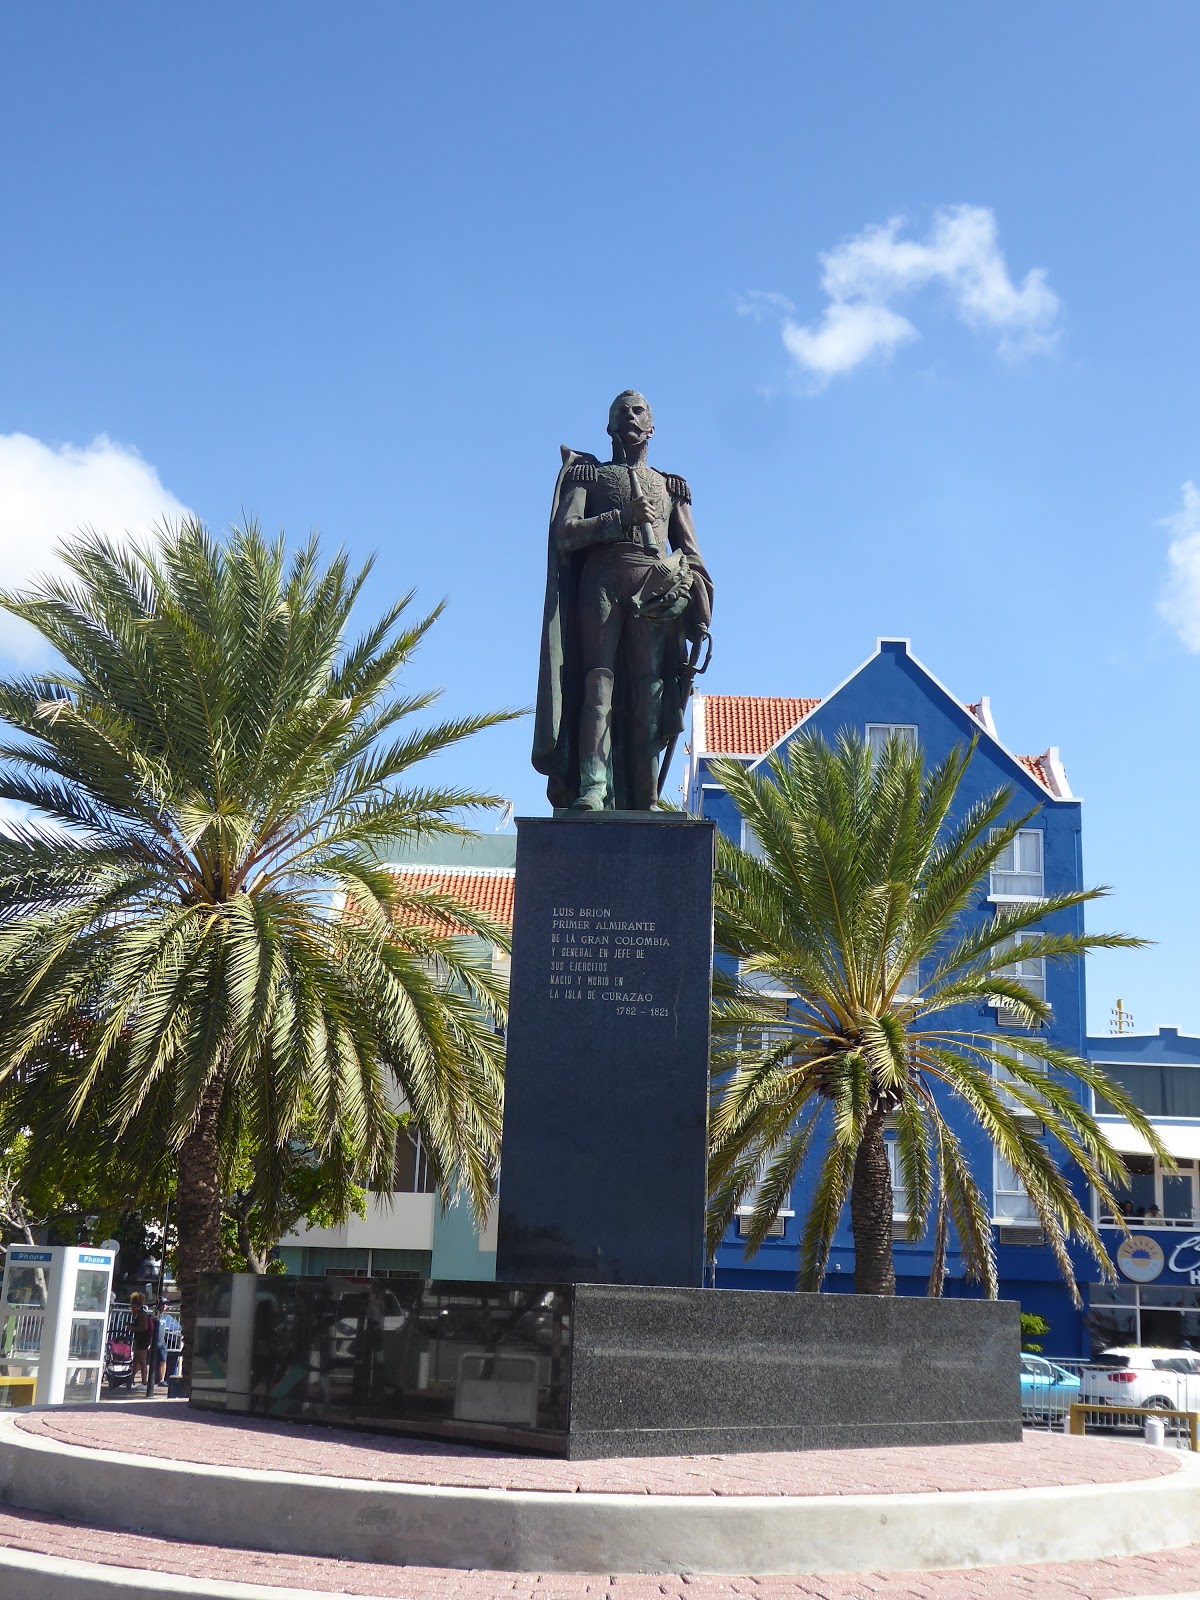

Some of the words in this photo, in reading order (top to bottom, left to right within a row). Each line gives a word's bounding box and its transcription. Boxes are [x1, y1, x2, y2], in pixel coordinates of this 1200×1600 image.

[552, 908, 574, 916] LUIS
[580, 908, 612, 918] BRION
[552, 920, 590, 930] PRIMER
[596, 922, 656, 932] ALMIRANTE
[552, 934, 560, 942] DE
[566, 934, 576, 943] LA
[581, 936, 609, 944] GRAN
[614, 936, 670, 946] COLOMBIA
[552, 947, 556, 956] Y
[562, 948, 592, 958] GENERAL
[600, 948, 608, 958] EN
[614, 949, 630, 958] JEFE
[636, 950, 644, 958] DE
[550, 962, 564, 970] SUS
[570, 962, 608, 972] EJERCITOS
[550, 975, 572, 984] NACIO
[578, 976, 582, 985] Y
[588, 976, 609, 986] MURIO
[614, 977, 624, 986] EN
[550, 990, 558, 998] LA
[565, 990, 582, 1000] ISLA
[588, 991, 596, 1000] DE
[602, 993, 653, 1002] CURAZAO
[616, 1007, 636, 1016] 1782
